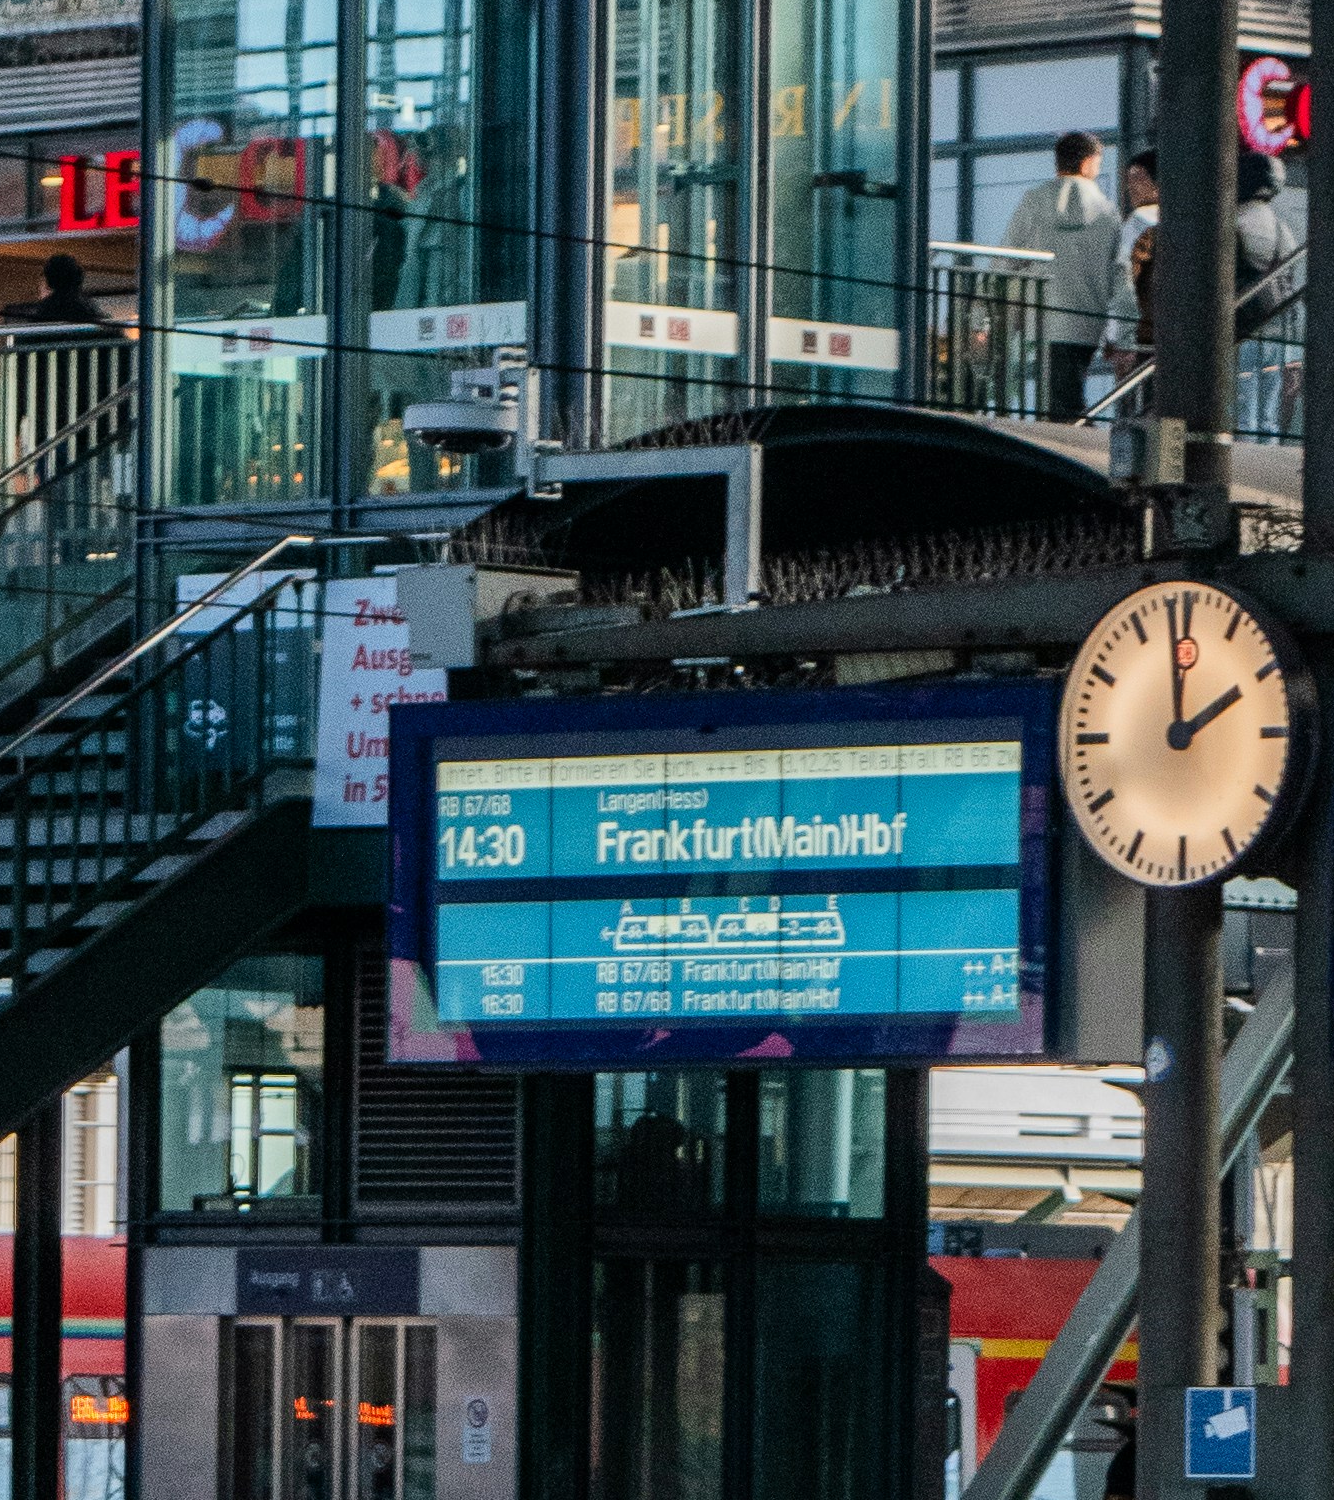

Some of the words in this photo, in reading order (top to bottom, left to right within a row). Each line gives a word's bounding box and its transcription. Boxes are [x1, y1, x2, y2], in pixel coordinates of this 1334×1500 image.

[495, 764, 533, 784] Bitte
[634, 757, 656, 780] Sie
[744, 754, 767, 775] Bis
[343, 774, 367, 803] in
[598, 788, 709, 815] Langen(Hess)
[439, 795, 460, 817] RB
[463, 793, 511, 816] 67/68
[439, 824, 526, 869] 14:30
[597, 812, 908, 865] Frankfurt(Main)Hbf
[621, 900, 635, 917] A
[679, 898, 692, 914] B
[739, 896, 751, 913] C
[827, 894, 839, 910] E
[482, 963, 524, 986] 15:30
[596, 961, 618, 985] RB
[622, 959, 673, 984] 67/68
[682, 957, 841, 982] Frankfurt(Main)Hbf
[482, 992, 524, 1015] 16:30
[596, 990, 618, 1014] RB
[622, 989, 673, 1013] 67/68
[682, 987, 841, 1012] Frankfurt(Main)Hbf
